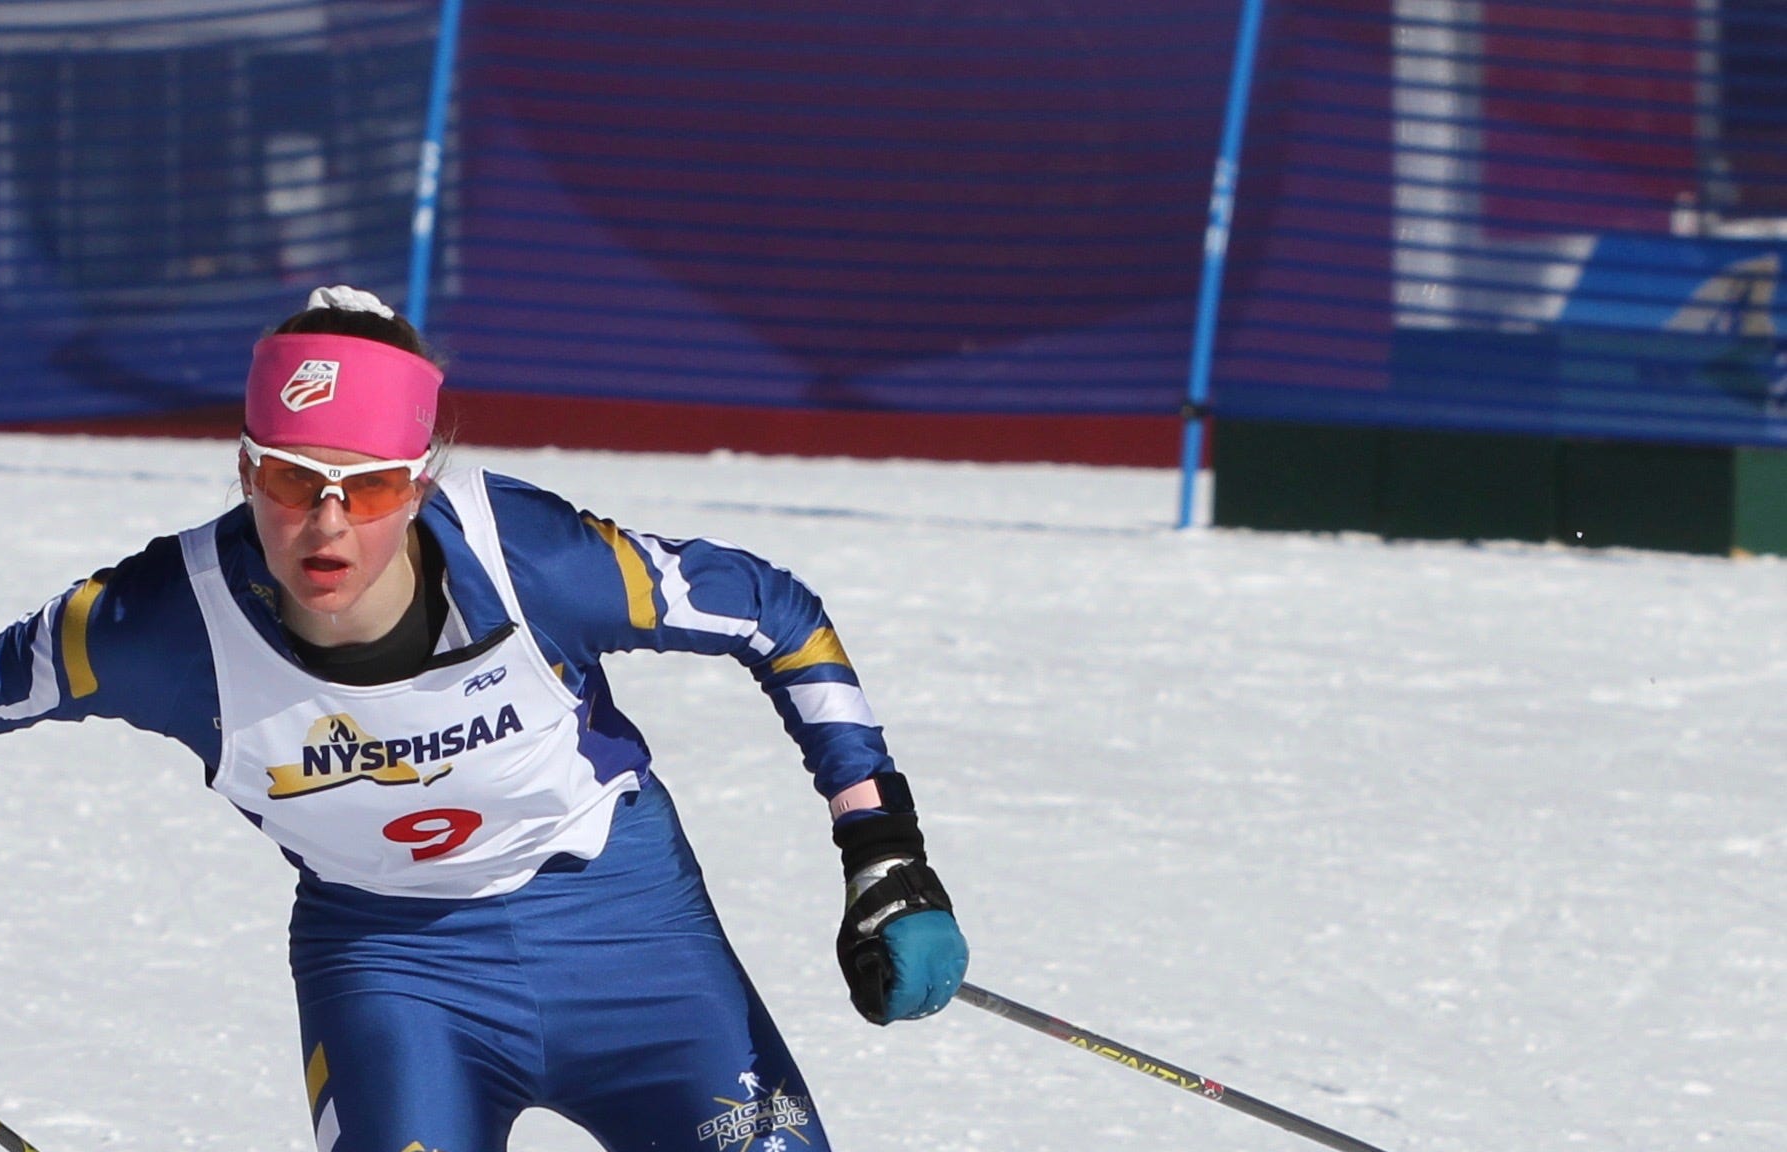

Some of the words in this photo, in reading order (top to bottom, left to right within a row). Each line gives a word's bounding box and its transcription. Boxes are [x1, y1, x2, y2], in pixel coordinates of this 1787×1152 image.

[302, 703, 523, 777] NYSPHSAA
[382, 808, 483, 861] 9
[697, 1096, 812, 1141] BRIGHTON
[717, 1109, 809, 1152] NORDIC
